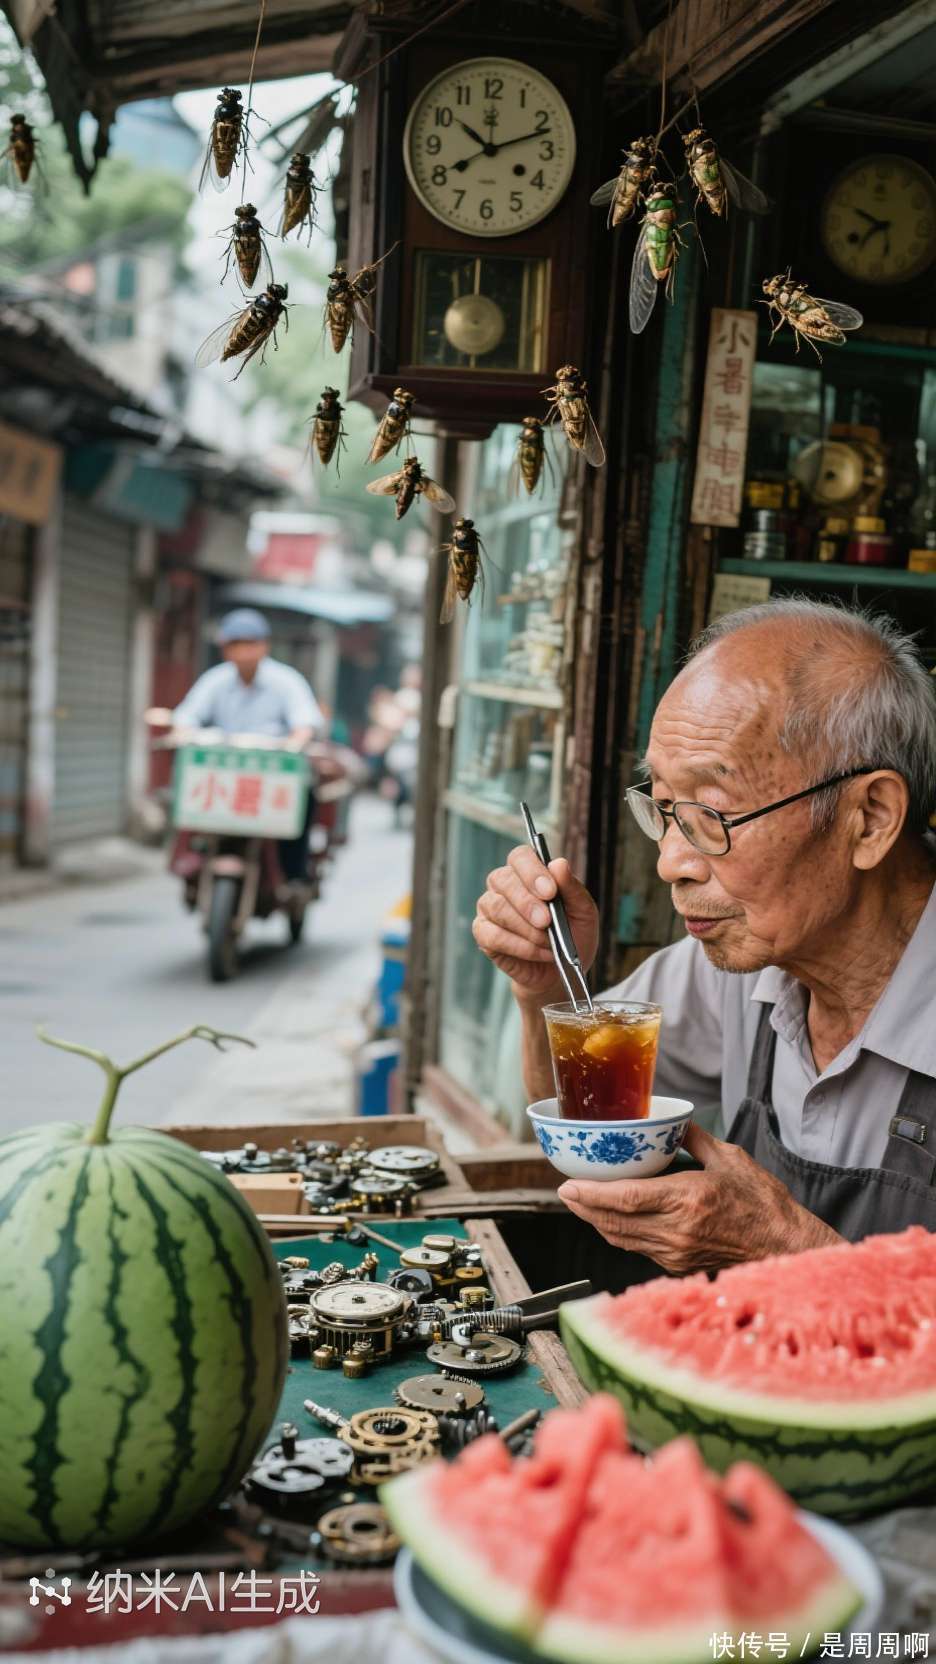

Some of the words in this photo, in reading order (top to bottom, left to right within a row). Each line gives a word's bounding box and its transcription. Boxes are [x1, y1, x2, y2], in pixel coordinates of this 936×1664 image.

[455, 85, 471, 105] 11
[484, 79, 504, 99] 12
[520, 88, 526, 108] 1
[435, 107, 453, 127] 10
[534, 111, 549, 132] 2
[426, 135, 441, 155] 9
[539, 140, 554, 161] 3
[431, 165, 447, 186] 8
[530, 169, 545, 190] 4
[453, 189, 466, 210] 7
[480, 200, 494, 219] 6
[510, 191, 523, 212] 5
